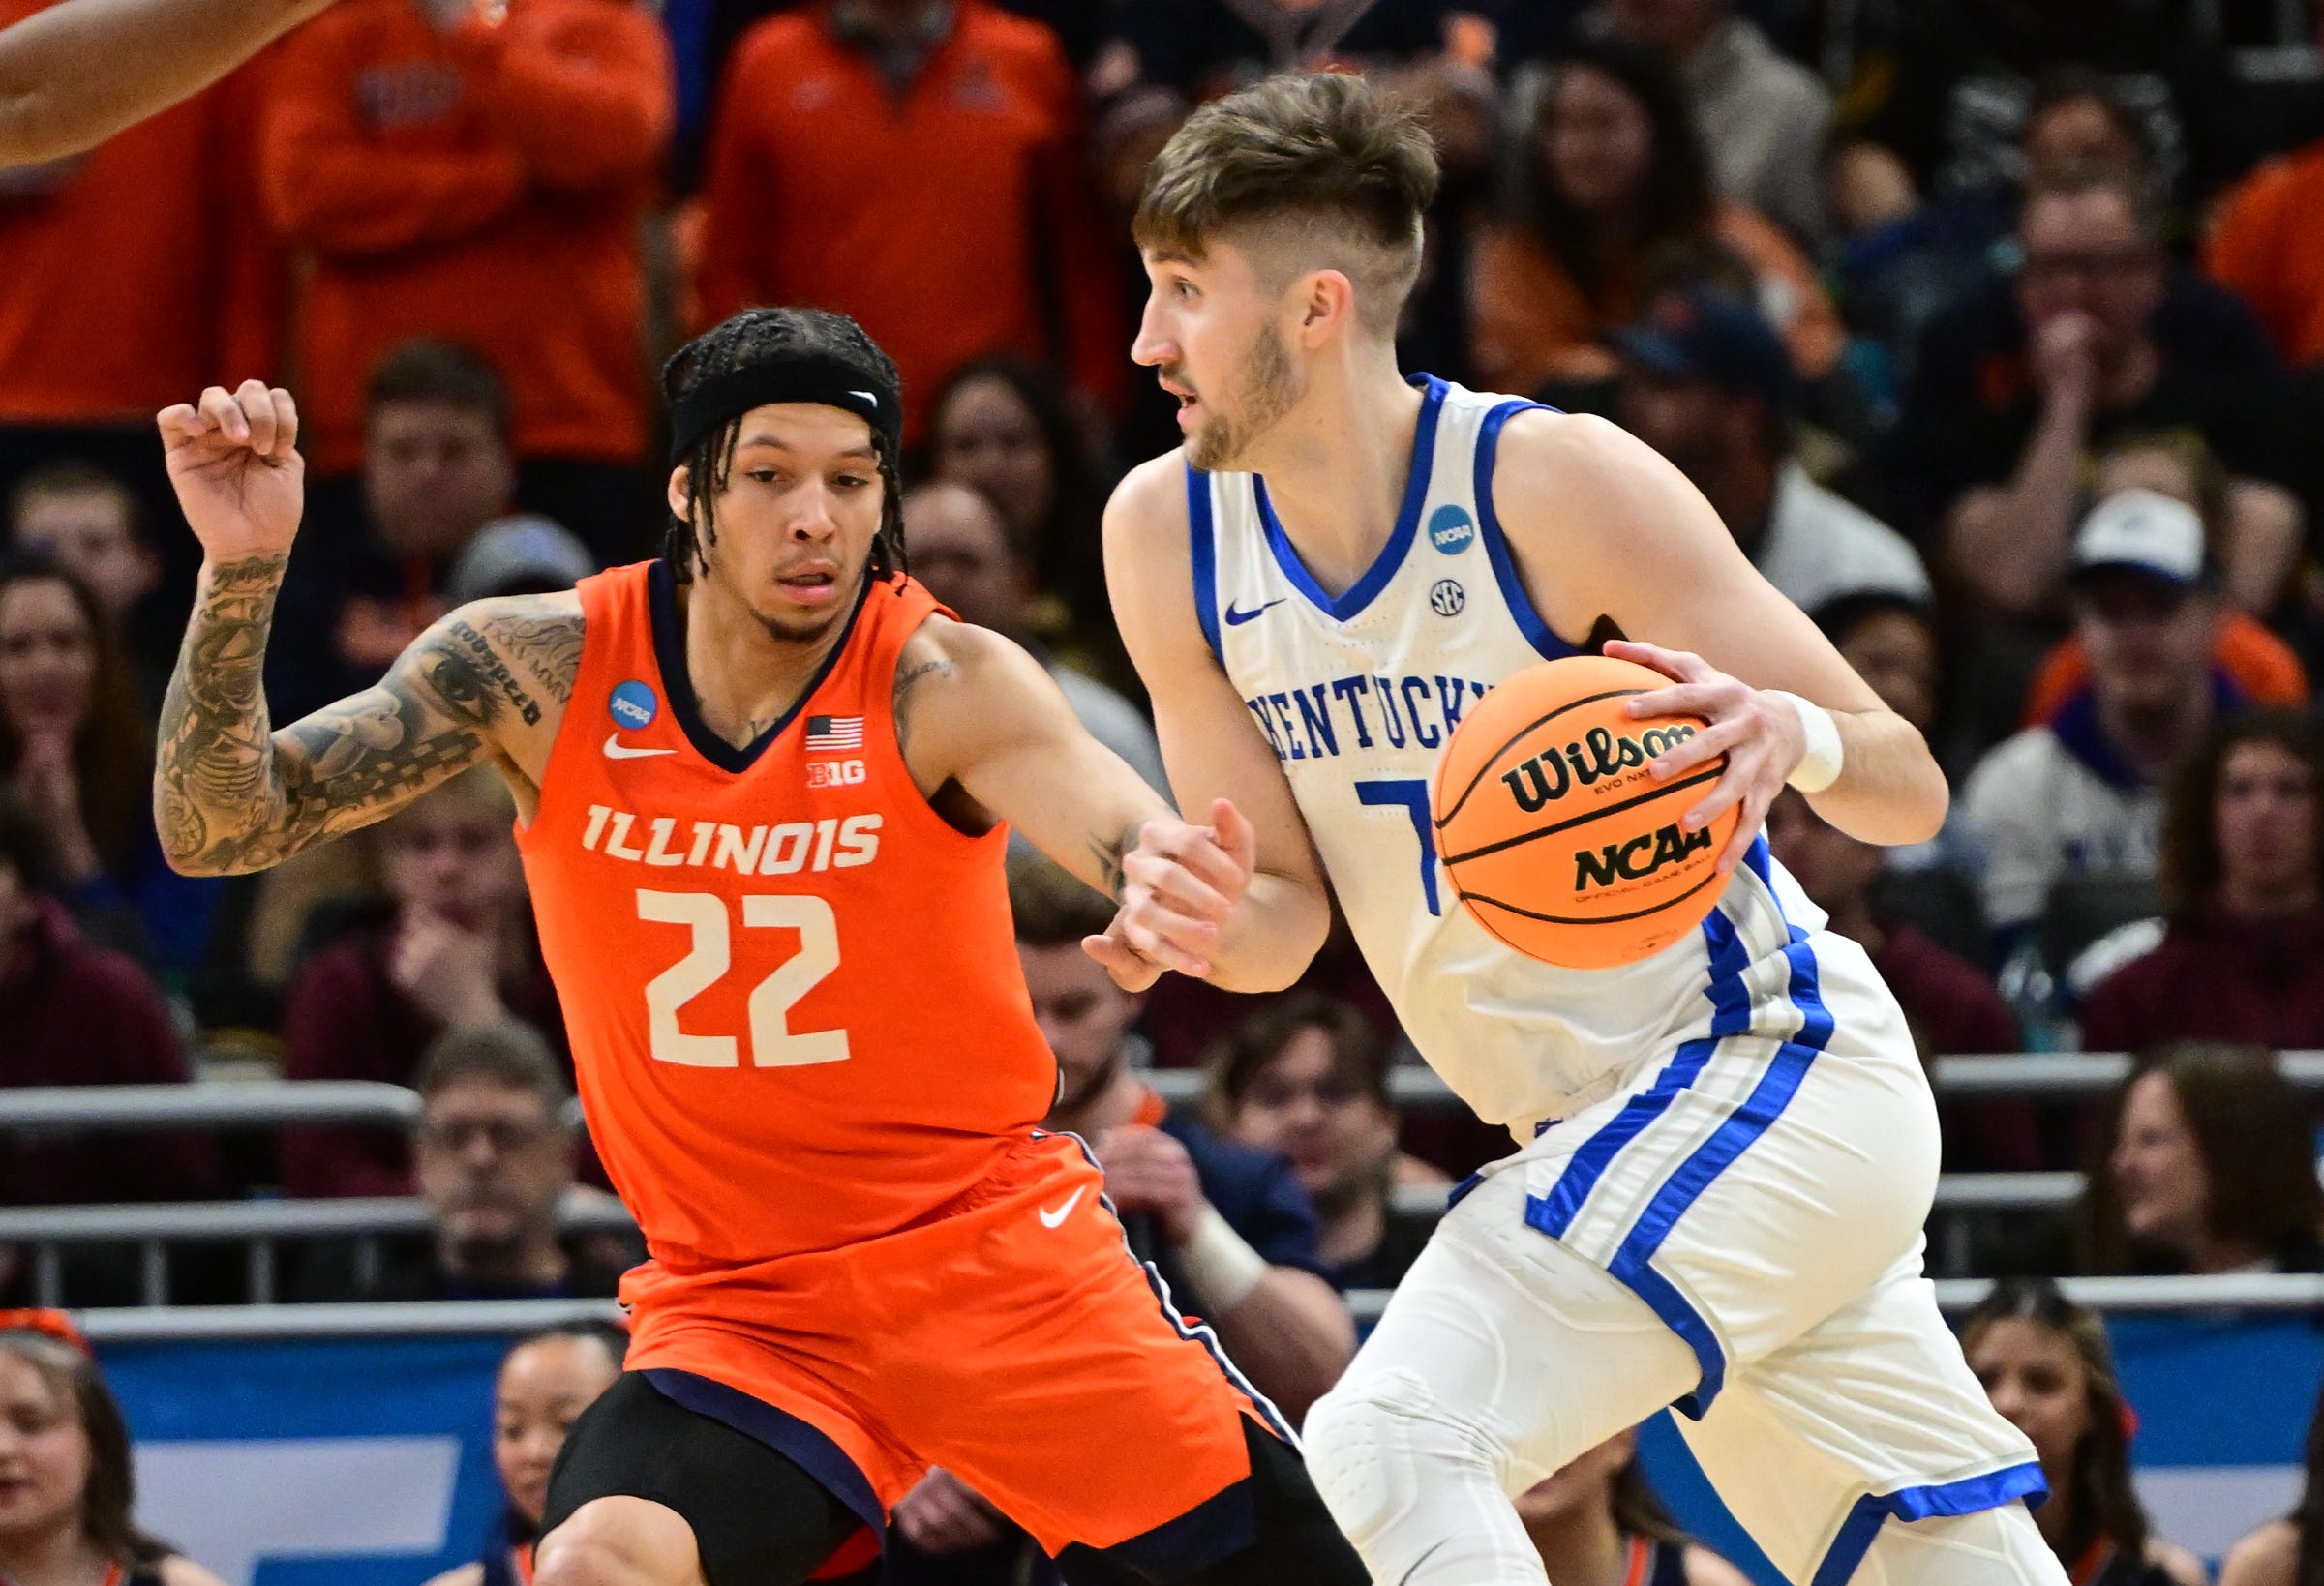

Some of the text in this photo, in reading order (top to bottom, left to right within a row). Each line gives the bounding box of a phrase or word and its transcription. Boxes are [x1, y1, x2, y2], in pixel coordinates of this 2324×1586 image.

[1434, 524, 1472, 546] NCAA
[612, 697, 651, 724] NCAA
[1248, 673, 1494, 761] KENTUCK
[1594, 779, 1622, 794] EVO
[582, 804, 884, 876] ILLINOIS
[1354, 779, 1441, 916] 7
[1574, 823, 1712, 891] NCAA
[635, 888, 850, 1068] 22
